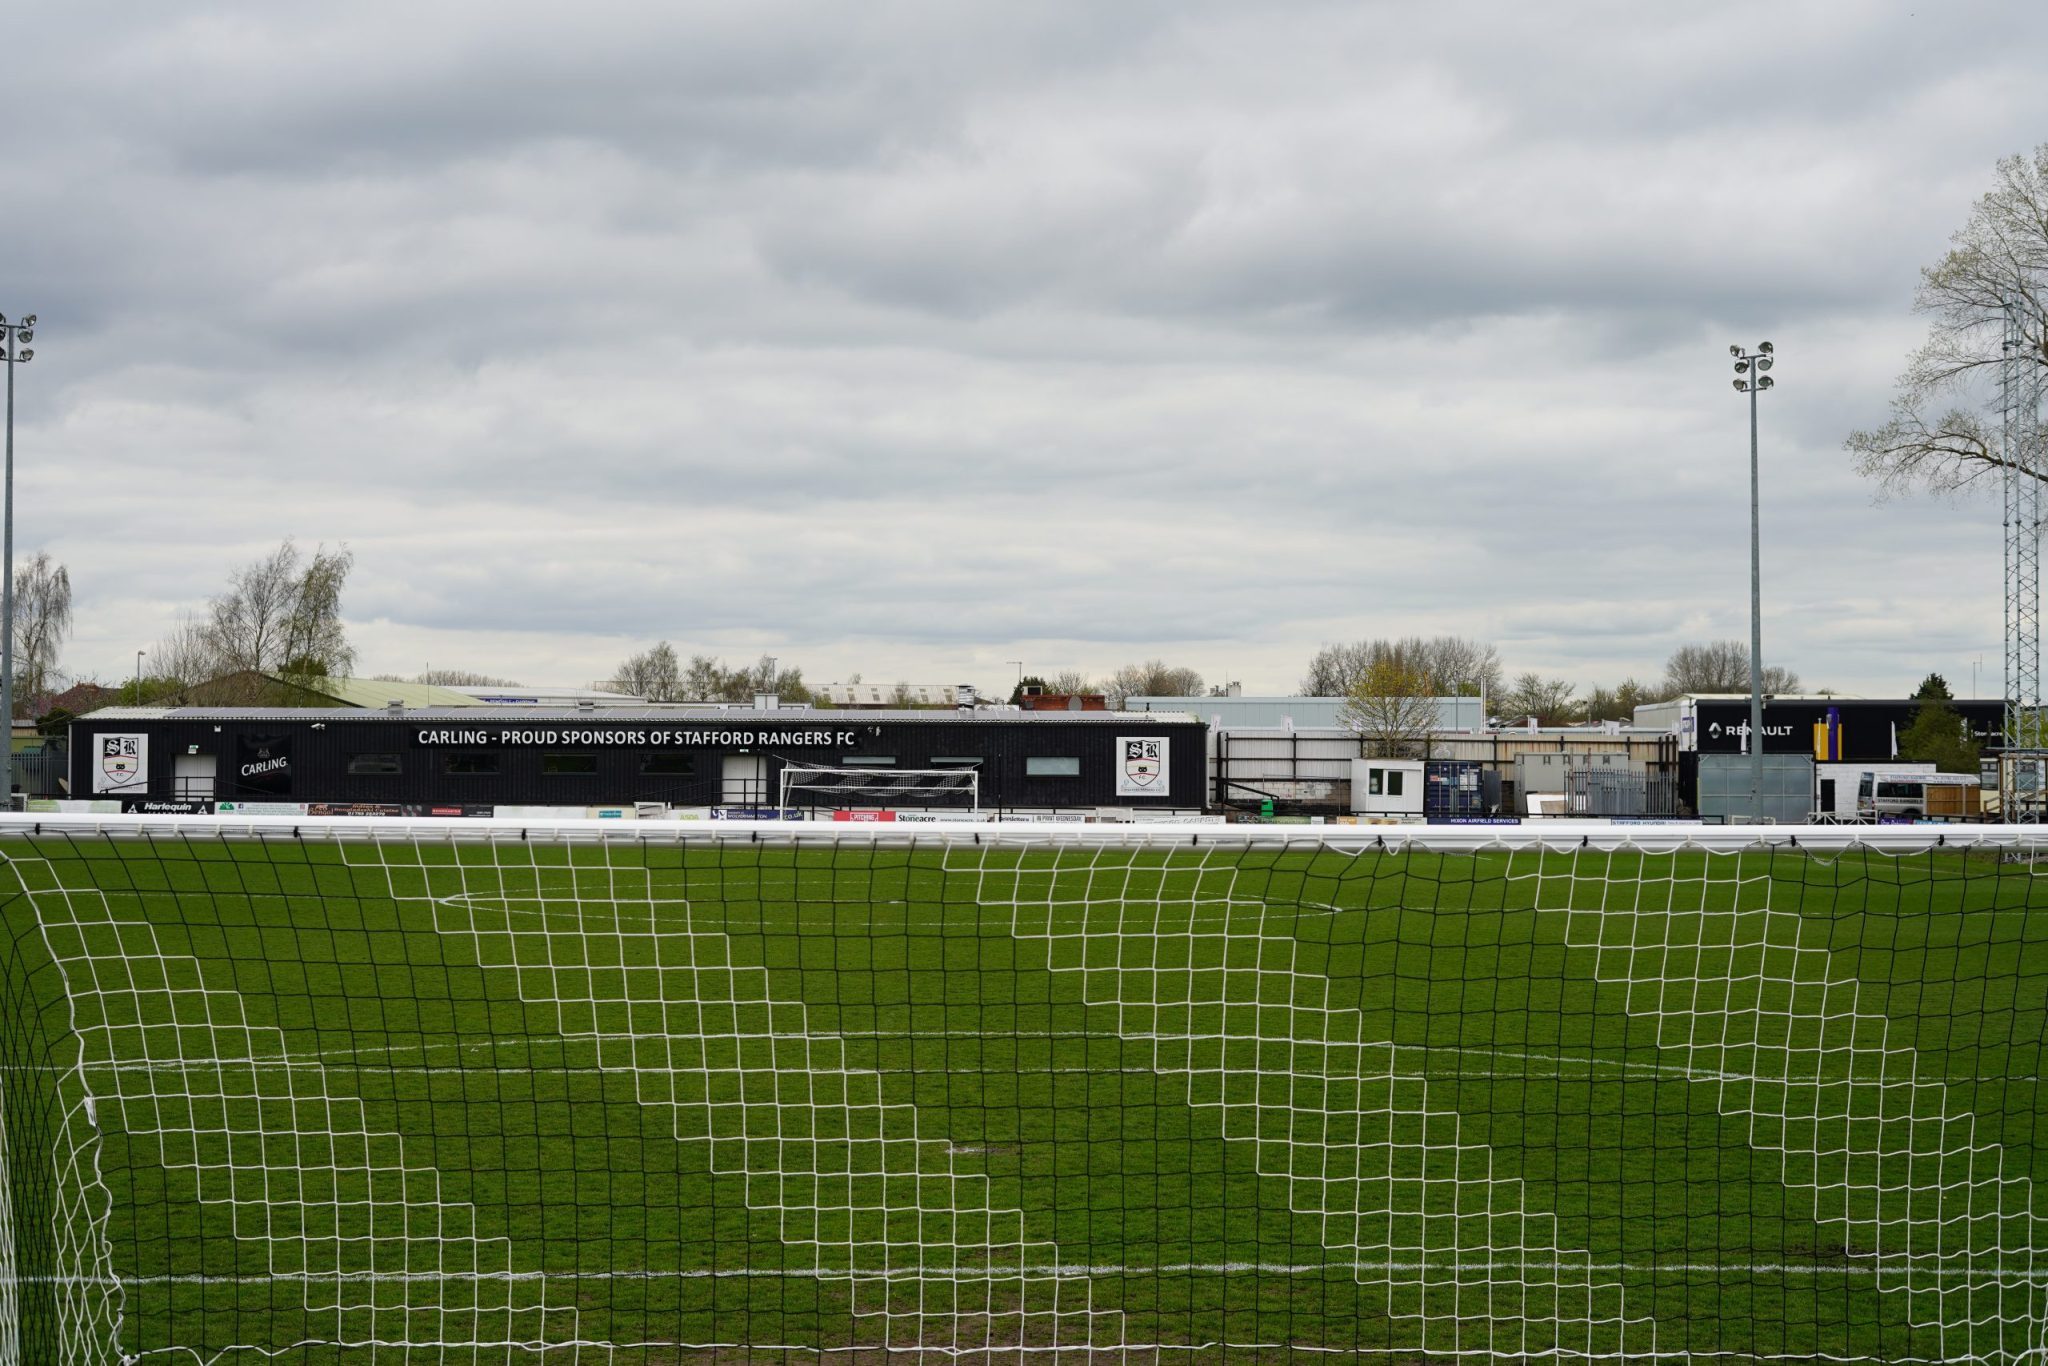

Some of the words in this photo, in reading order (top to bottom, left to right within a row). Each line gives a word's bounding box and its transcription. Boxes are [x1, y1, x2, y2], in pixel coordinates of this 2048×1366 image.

[418, 730, 487, 745] CARLING
[501, 730, 558, 745] PROUD
[561, 730, 646, 745] SPONSORS
[650, 730, 671, 745] OF
[674, 730, 754, 746] STAFFORD
[758, 731, 832, 746] RANGERS
[836, 731, 855, 746] FC
[241, 756, 288, 777] CARLING
[144, 802, 192, 812] Harlequin
[898, 814, 936, 822] Stoneacre
